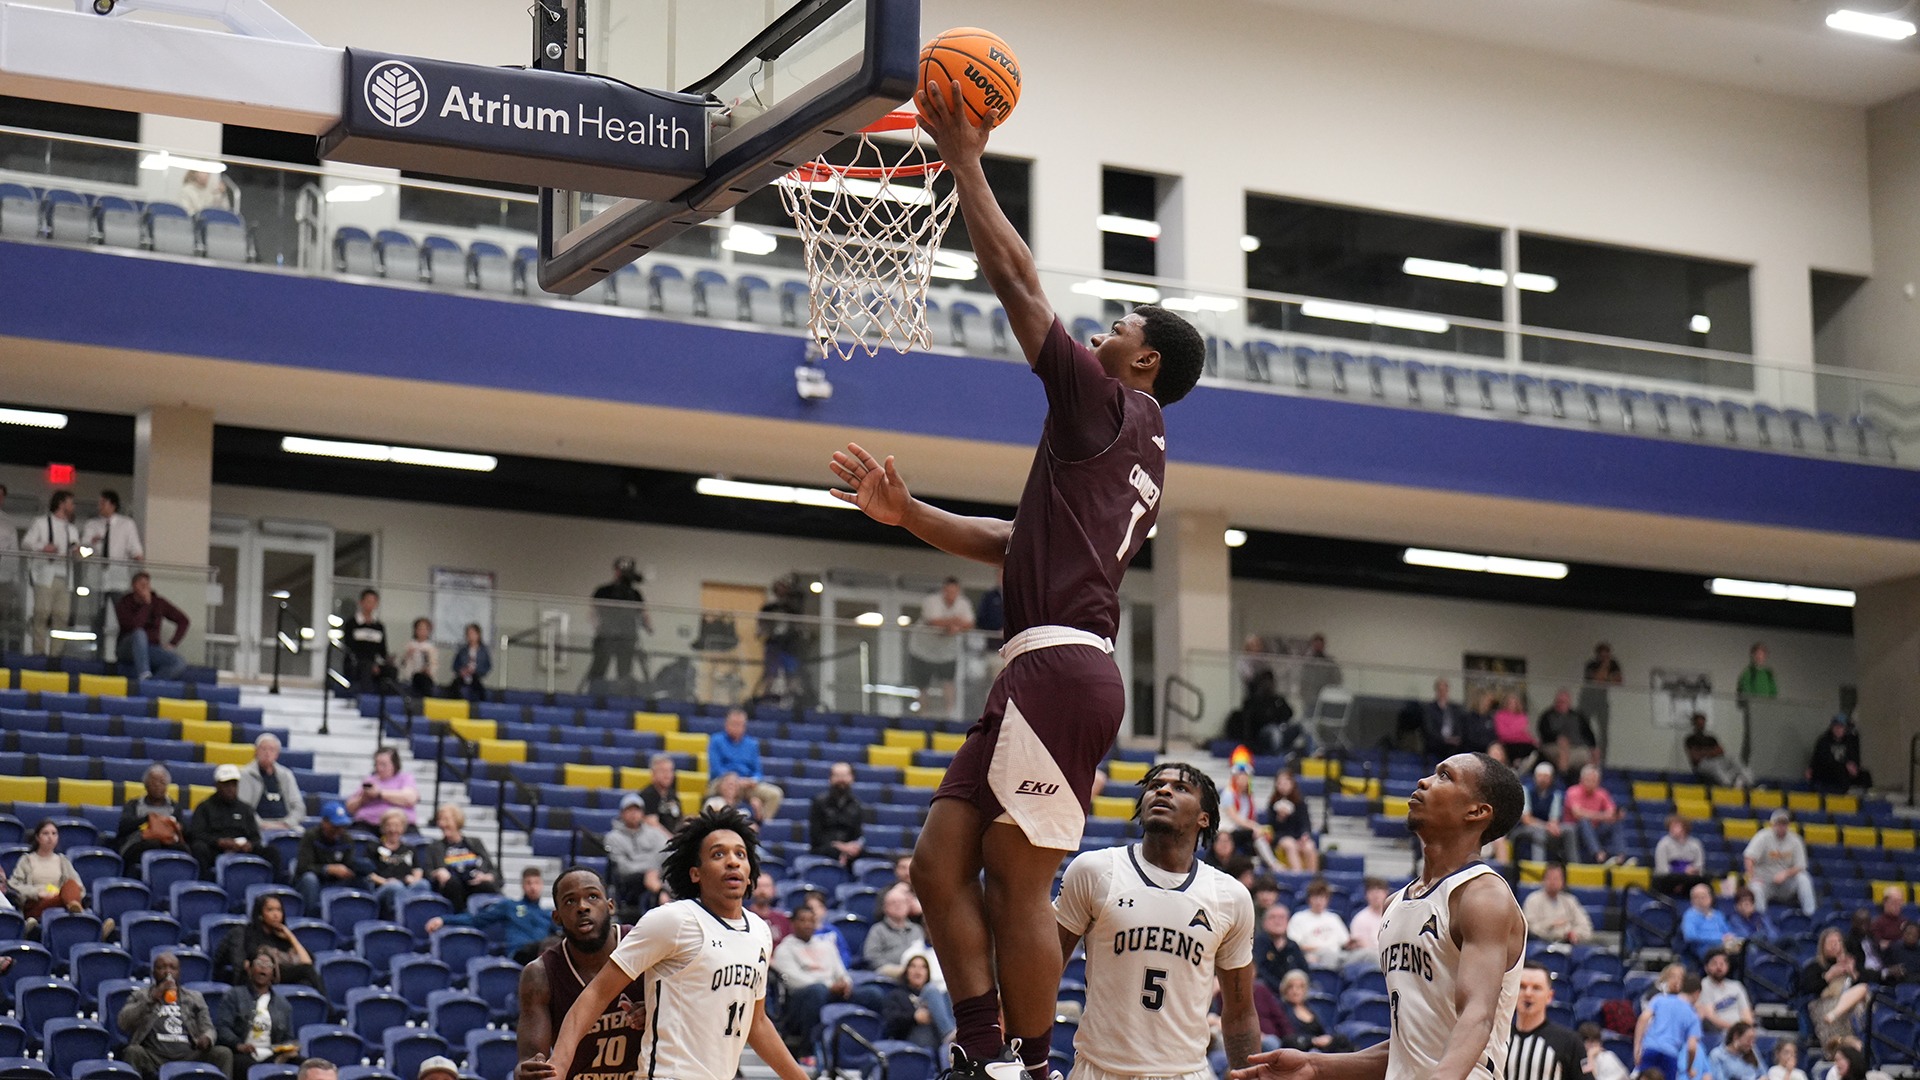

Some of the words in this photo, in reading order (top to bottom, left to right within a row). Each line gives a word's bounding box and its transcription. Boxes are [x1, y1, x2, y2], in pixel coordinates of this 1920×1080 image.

[964, 63, 1011, 121] Wilson
[440, 85, 570, 135] Atrium
[578, 103, 690, 151] Health
[1115, 500, 1147, 562] 1
[1017, 780, 1060, 795] EKU
[1113, 926, 1205, 967] QUEENS
[1382, 942, 1433, 982] UEENS
[1140, 966, 1169, 1012] 5
[591, 1035, 628, 1069] 10
